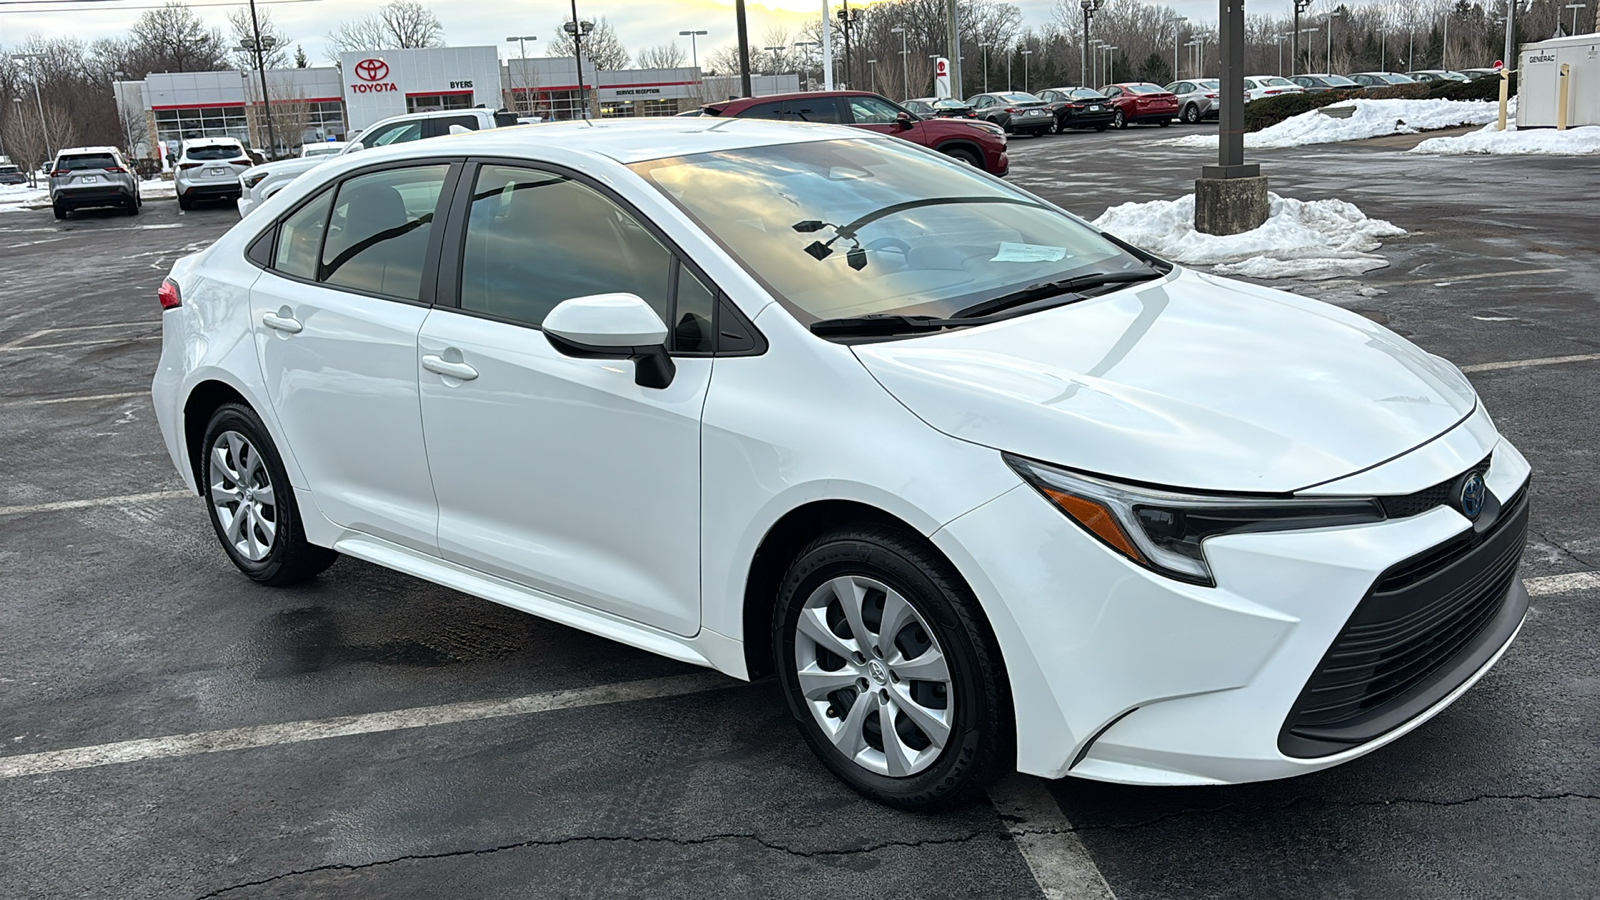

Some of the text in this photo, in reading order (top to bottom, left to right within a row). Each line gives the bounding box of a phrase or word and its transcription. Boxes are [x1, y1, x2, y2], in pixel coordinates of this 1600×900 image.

[1529, 55, 1555, 63] GENERAC
[351, 83, 397, 93] TOYOTA
[450, 81, 473, 89] BYERS
[889, 746, 976, 804] Firestone
